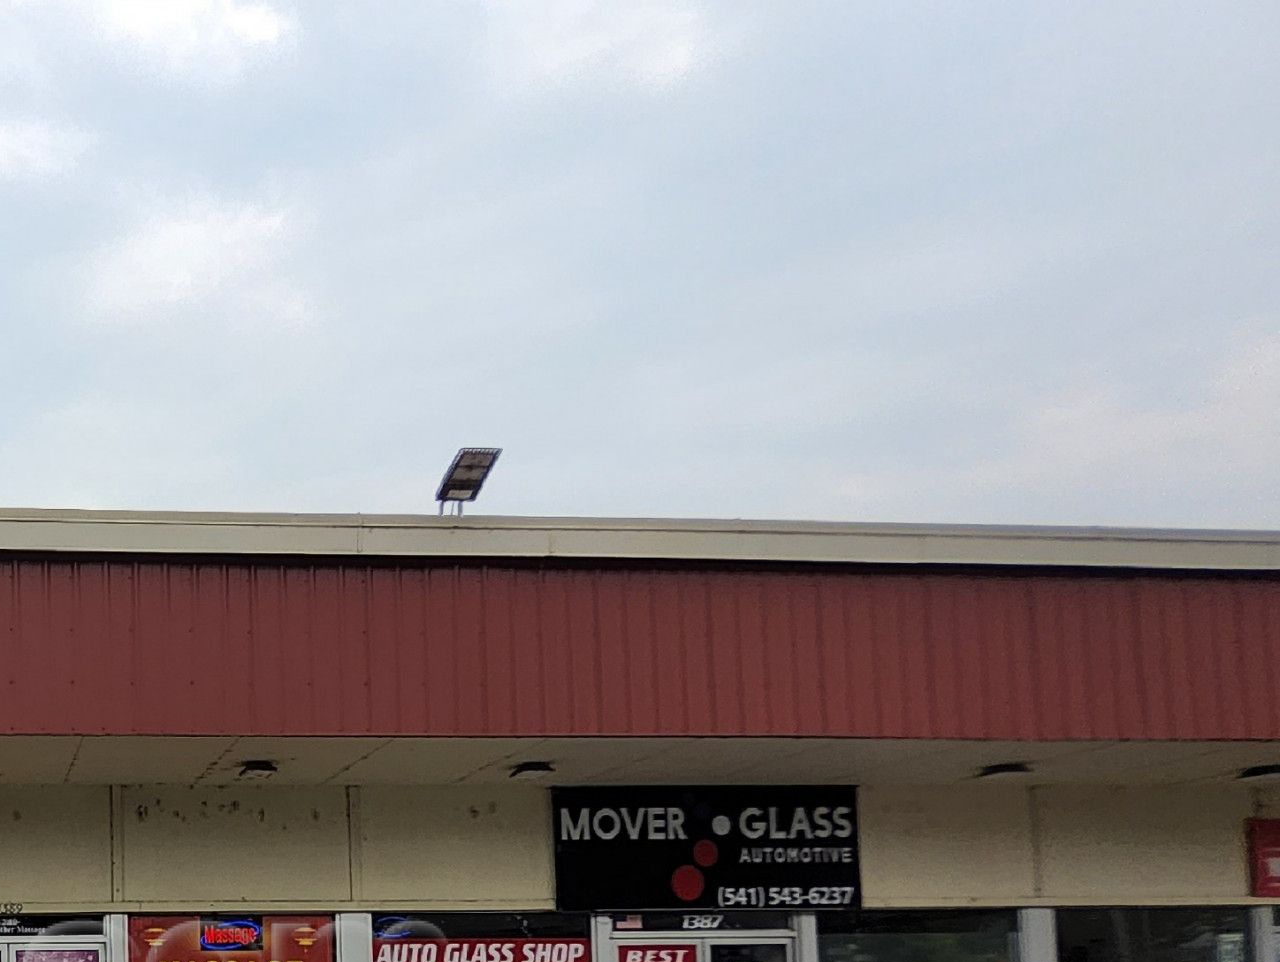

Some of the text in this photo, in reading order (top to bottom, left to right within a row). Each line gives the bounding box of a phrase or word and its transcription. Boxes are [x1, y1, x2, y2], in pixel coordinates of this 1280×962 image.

[559, 806, 853, 841] MOVER GLASS
[738, 847, 853, 864] AUTOMOTIVE
[717, 886, 855, 907] (541) 543-6237
[682, 914, 724, 929] 1387
[204, 925, 257, 945] Massage
